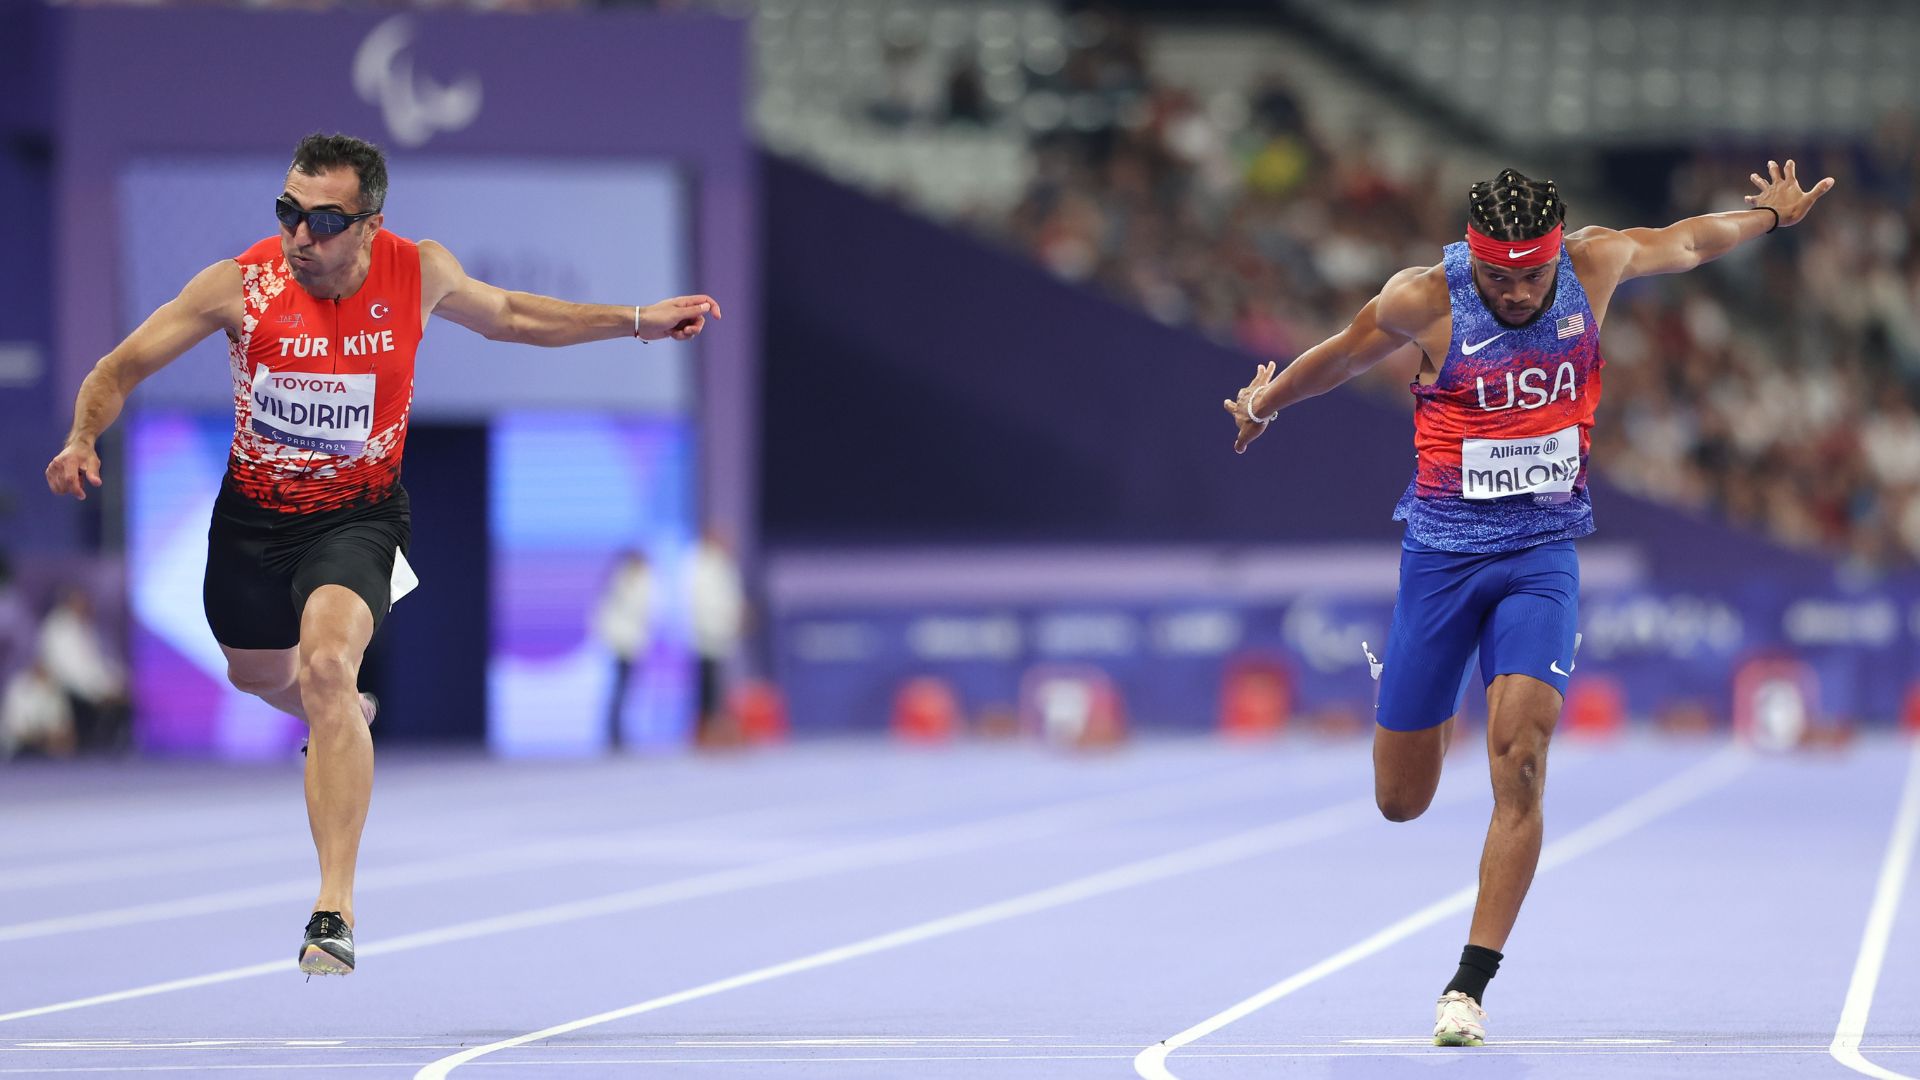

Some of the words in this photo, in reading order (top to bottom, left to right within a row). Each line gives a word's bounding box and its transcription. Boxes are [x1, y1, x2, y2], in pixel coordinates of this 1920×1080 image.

[279, 334, 328, 357] TÜR
[343, 330, 394, 356] KİYE
[272, 378, 347, 393] TOYOTA
[1477, 362, 1576, 411] USA
[254, 392, 369, 429] YILDIRIM
[287, 437, 316, 447] PARIS
[319, 443, 346, 451] 2024
[1490, 444, 1541, 459] Allianz
[1469, 457, 1578, 492] MALONE
